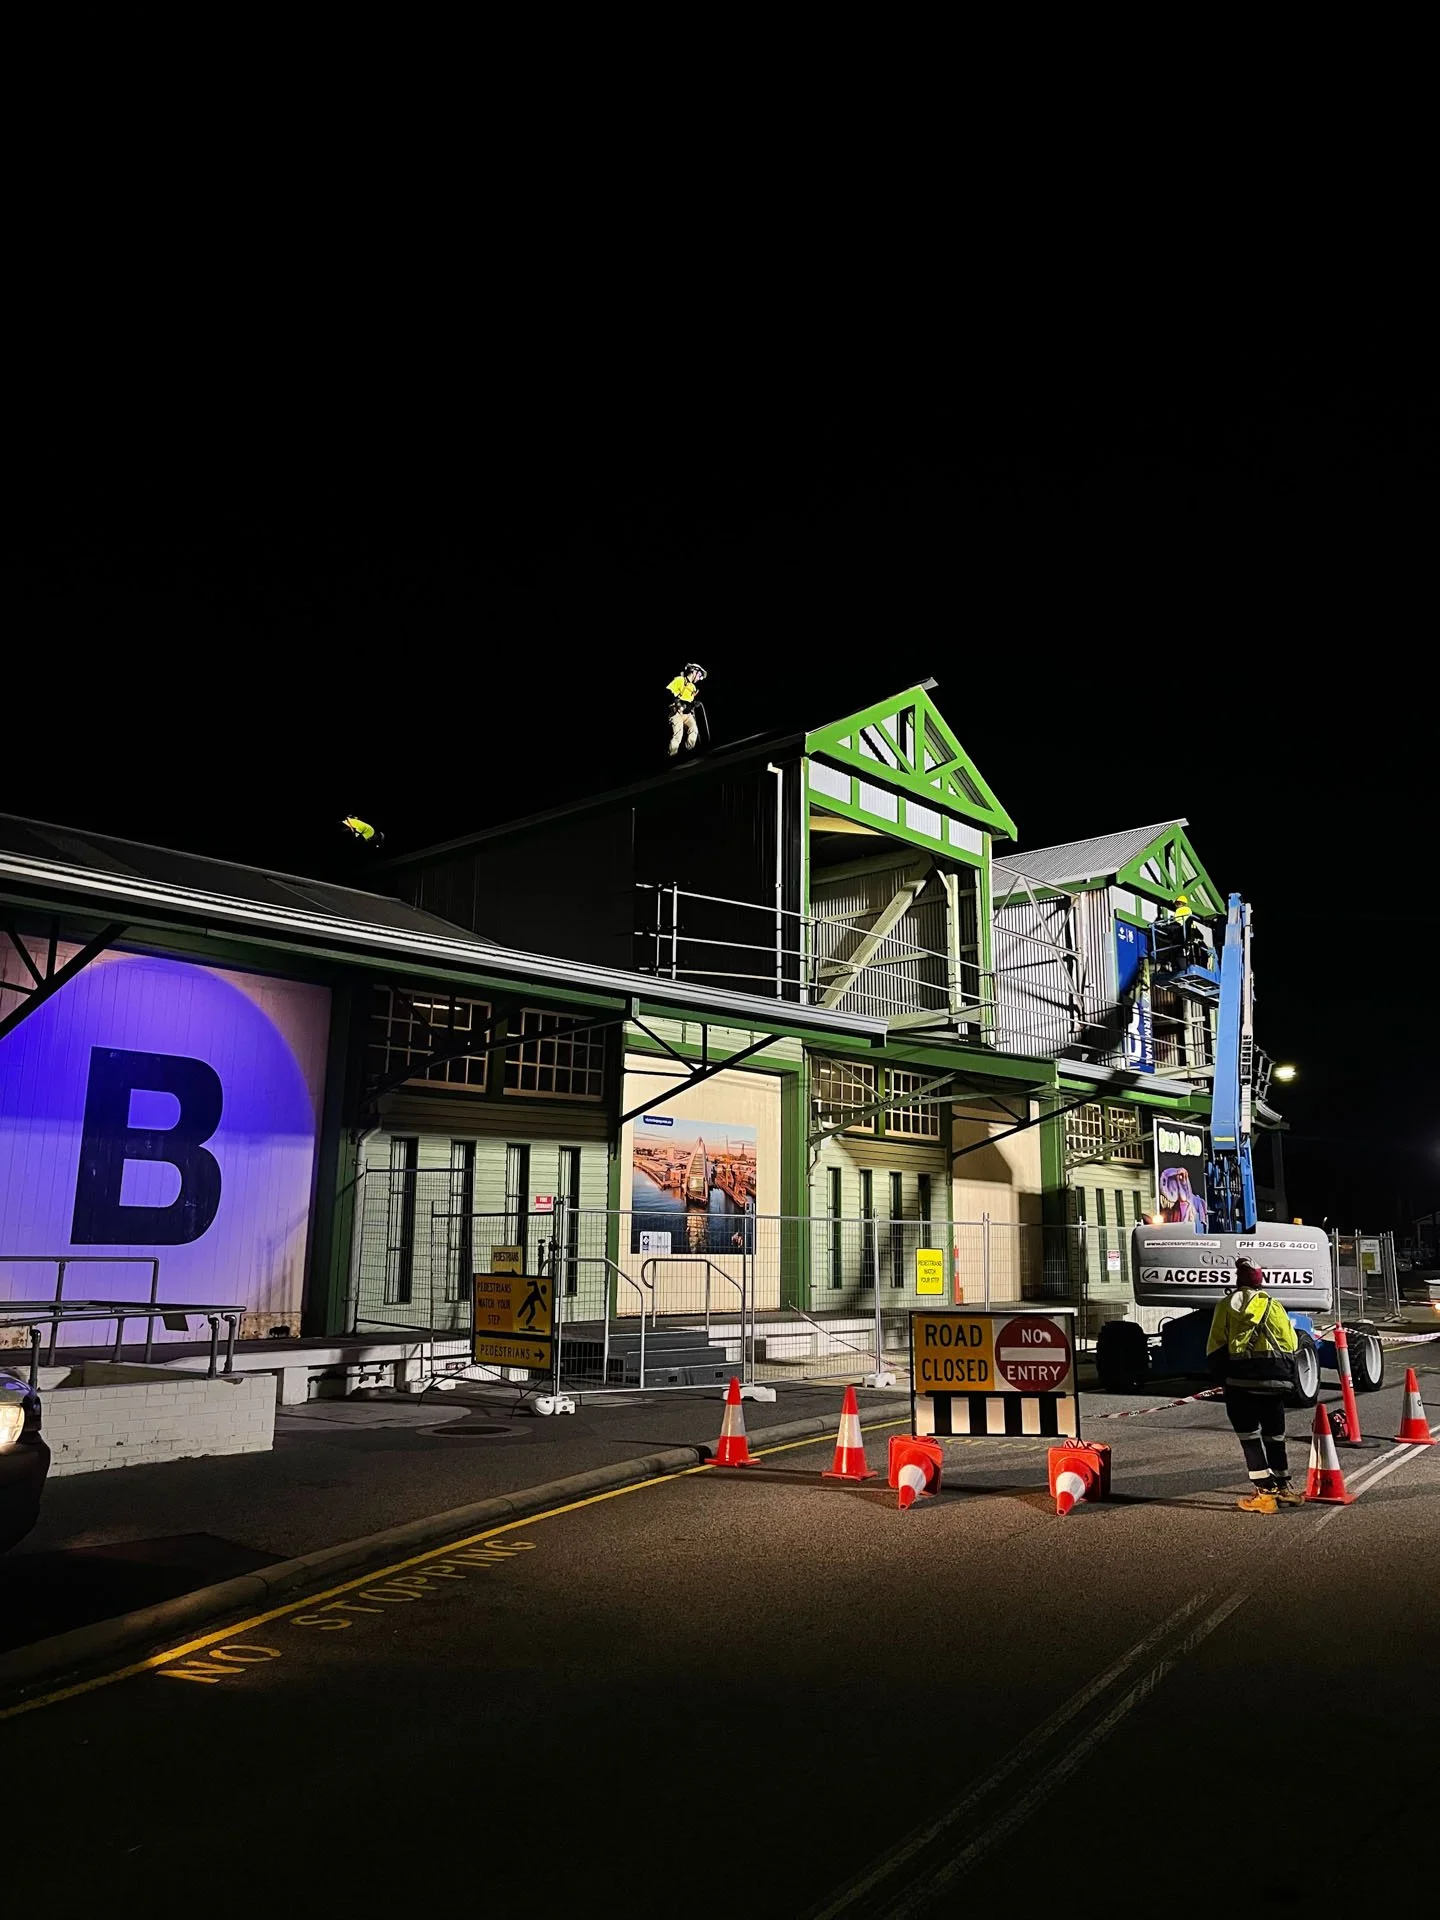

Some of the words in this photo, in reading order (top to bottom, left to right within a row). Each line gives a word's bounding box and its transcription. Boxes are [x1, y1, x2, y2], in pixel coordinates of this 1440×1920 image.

[69, 1046, 224, 1246] B
[1258, 1241, 1286, 1249] 9456
[1288, 1242, 1316, 1250] 4400
[1164, 1269, 1231, 1284] ACCESS
[477, 1281, 512, 1294] PEDESTRIANS
[477, 1299, 495, 1309] WATCH
[487, 1314, 501, 1325] STEP
[925, 1323, 983, 1347] ROAD
[1021, 1328, 1043, 1344] NO
[480, 1344, 530, 1360] PEDESTRIANS
[922, 1358, 988, 1382] CLOSED
[1007, 1365, 1061, 1381] ENTRY
[156, 1645, 282, 1684] NO
[291, 1540, 537, 1631] STOPPING
